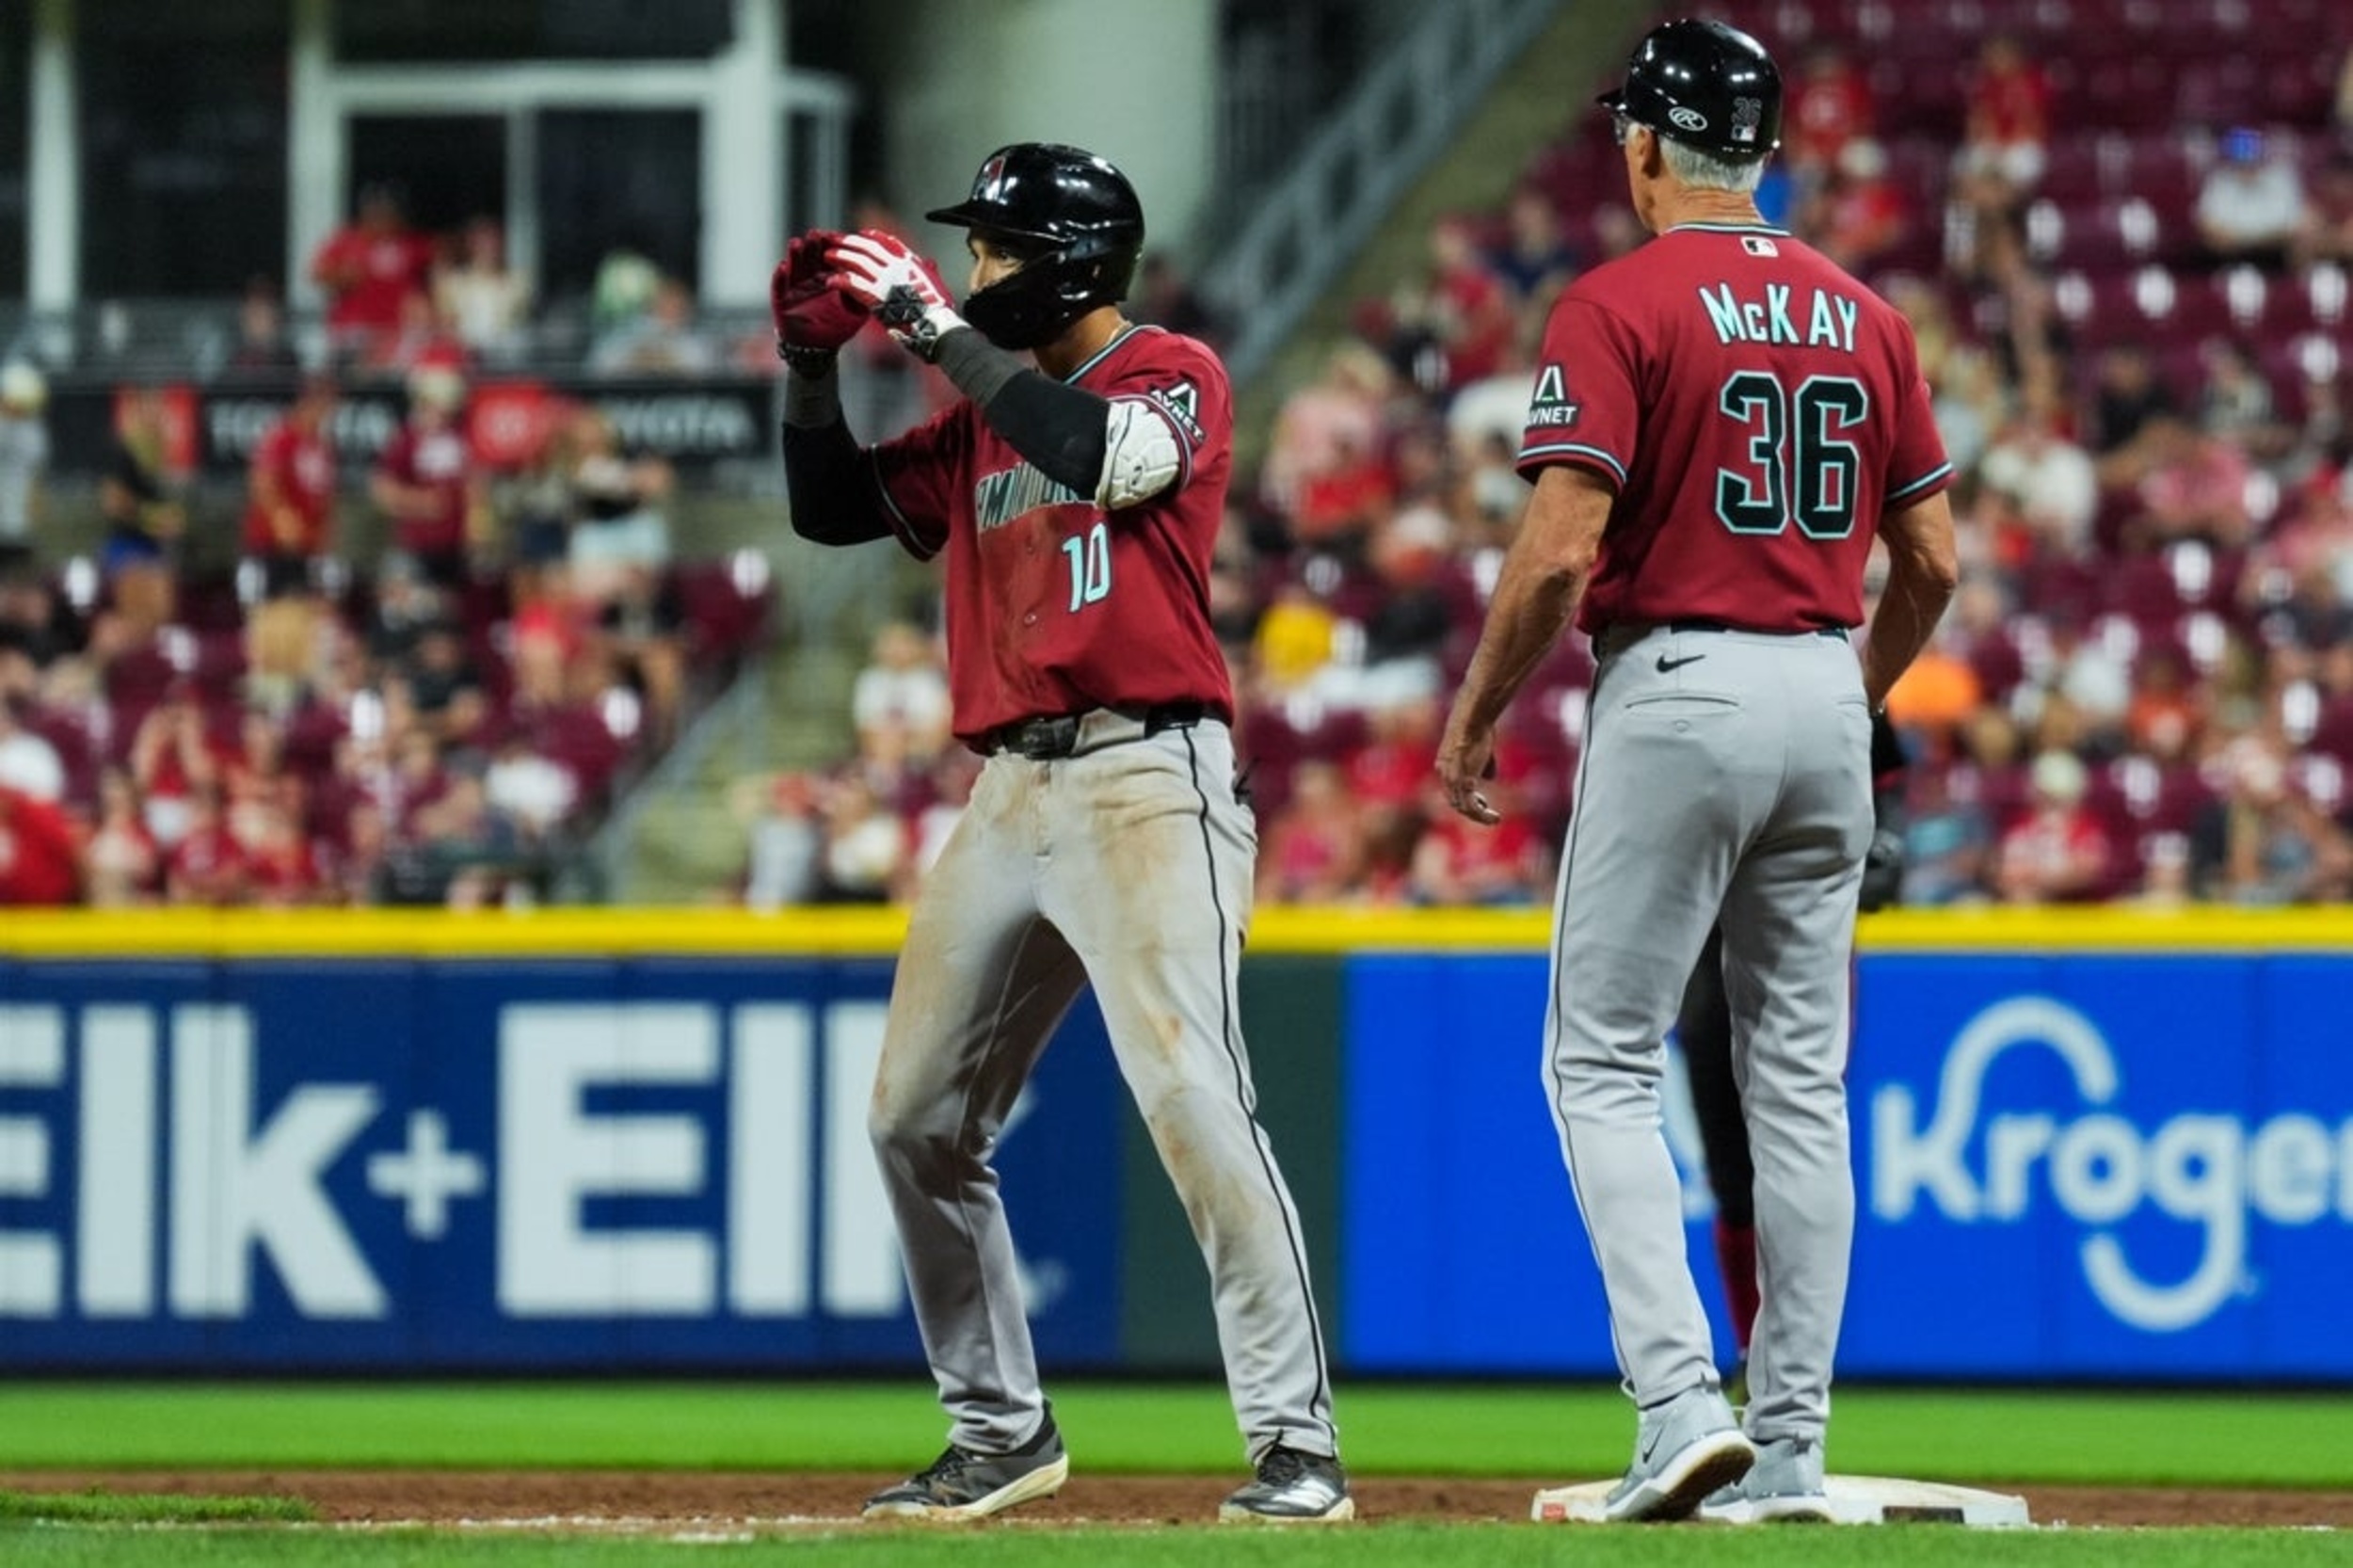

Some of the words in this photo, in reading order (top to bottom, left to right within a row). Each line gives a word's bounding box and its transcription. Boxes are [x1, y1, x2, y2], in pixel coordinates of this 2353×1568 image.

[1698, 282, 1858, 353] McKAY
[1715, 370, 1868, 540] 36
[1061, 520, 1112, 615] 10
